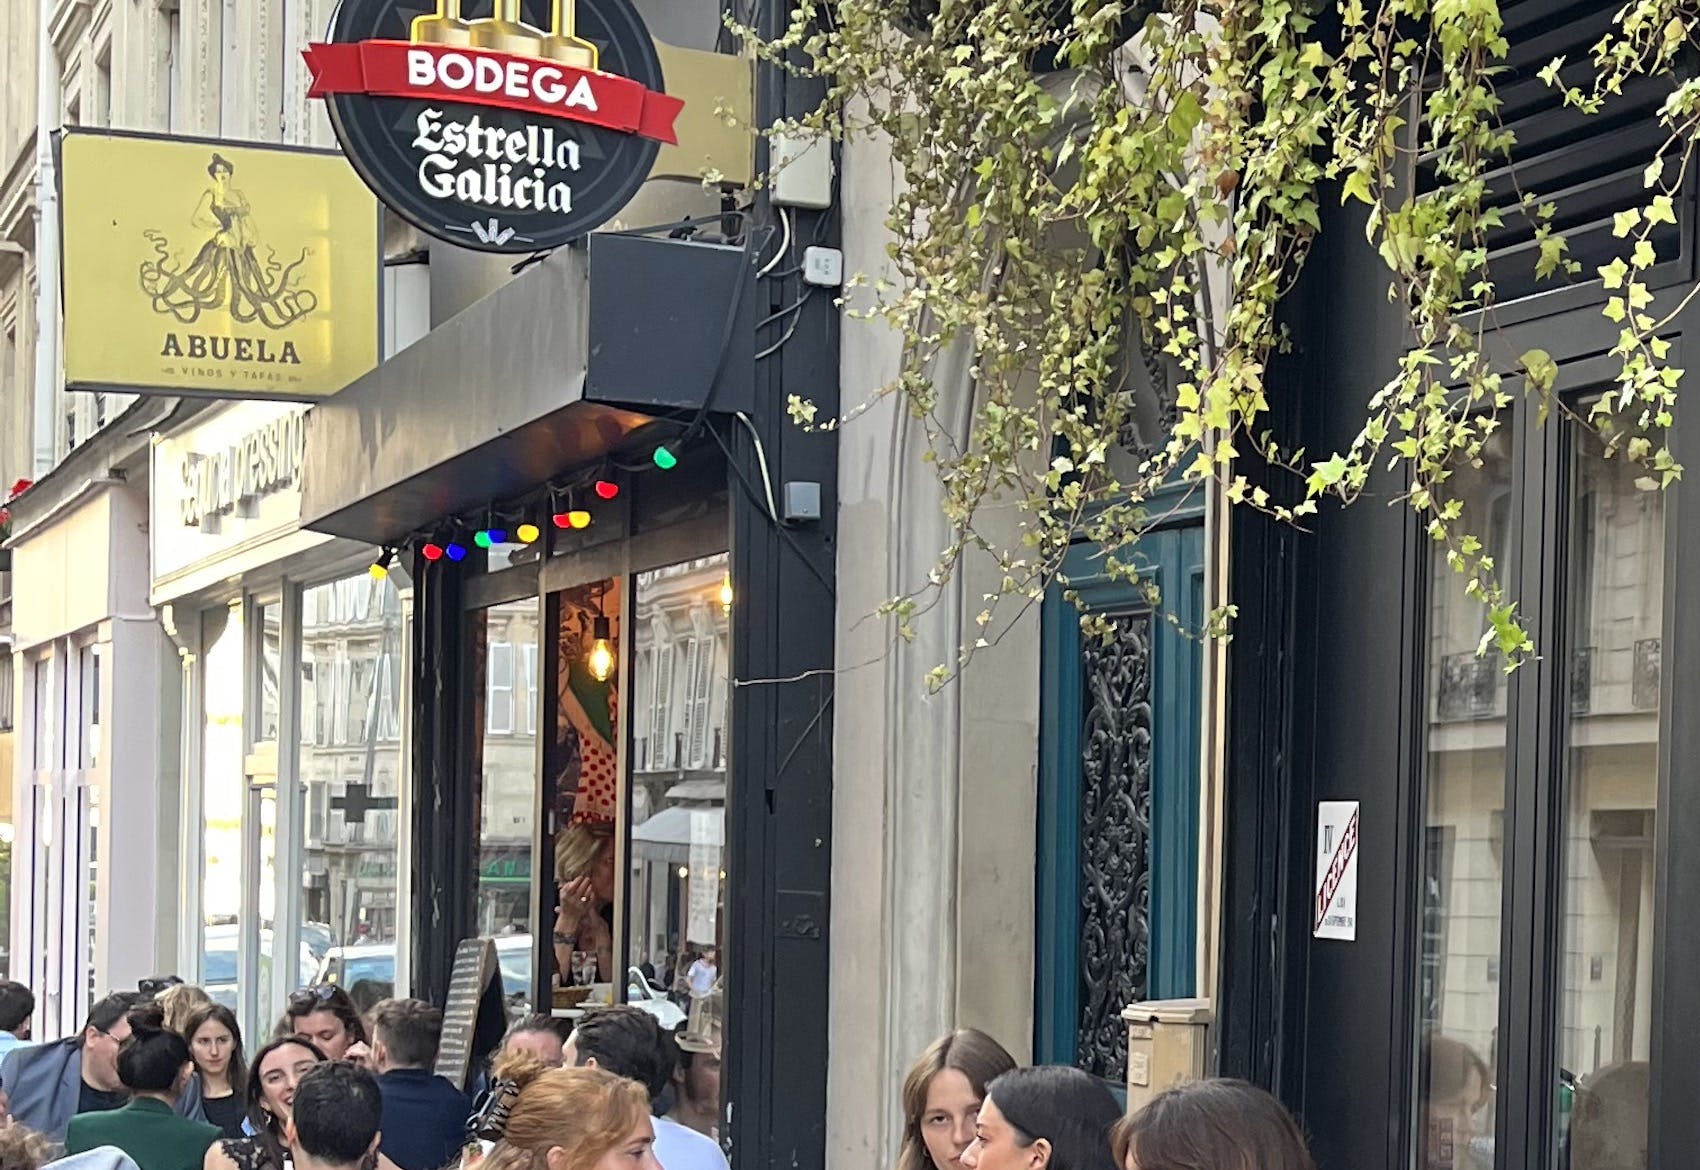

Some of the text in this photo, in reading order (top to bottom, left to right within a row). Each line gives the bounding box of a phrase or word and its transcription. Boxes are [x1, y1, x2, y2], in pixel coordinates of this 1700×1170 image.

[407, 50, 599, 112] BODEGA
[412, 108, 583, 172] Estrella
[418, 154, 574, 214] Galicia
[161, 333, 301, 364] ABUELA
[182, 367, 281, 381] VINOS Y TAPAS
